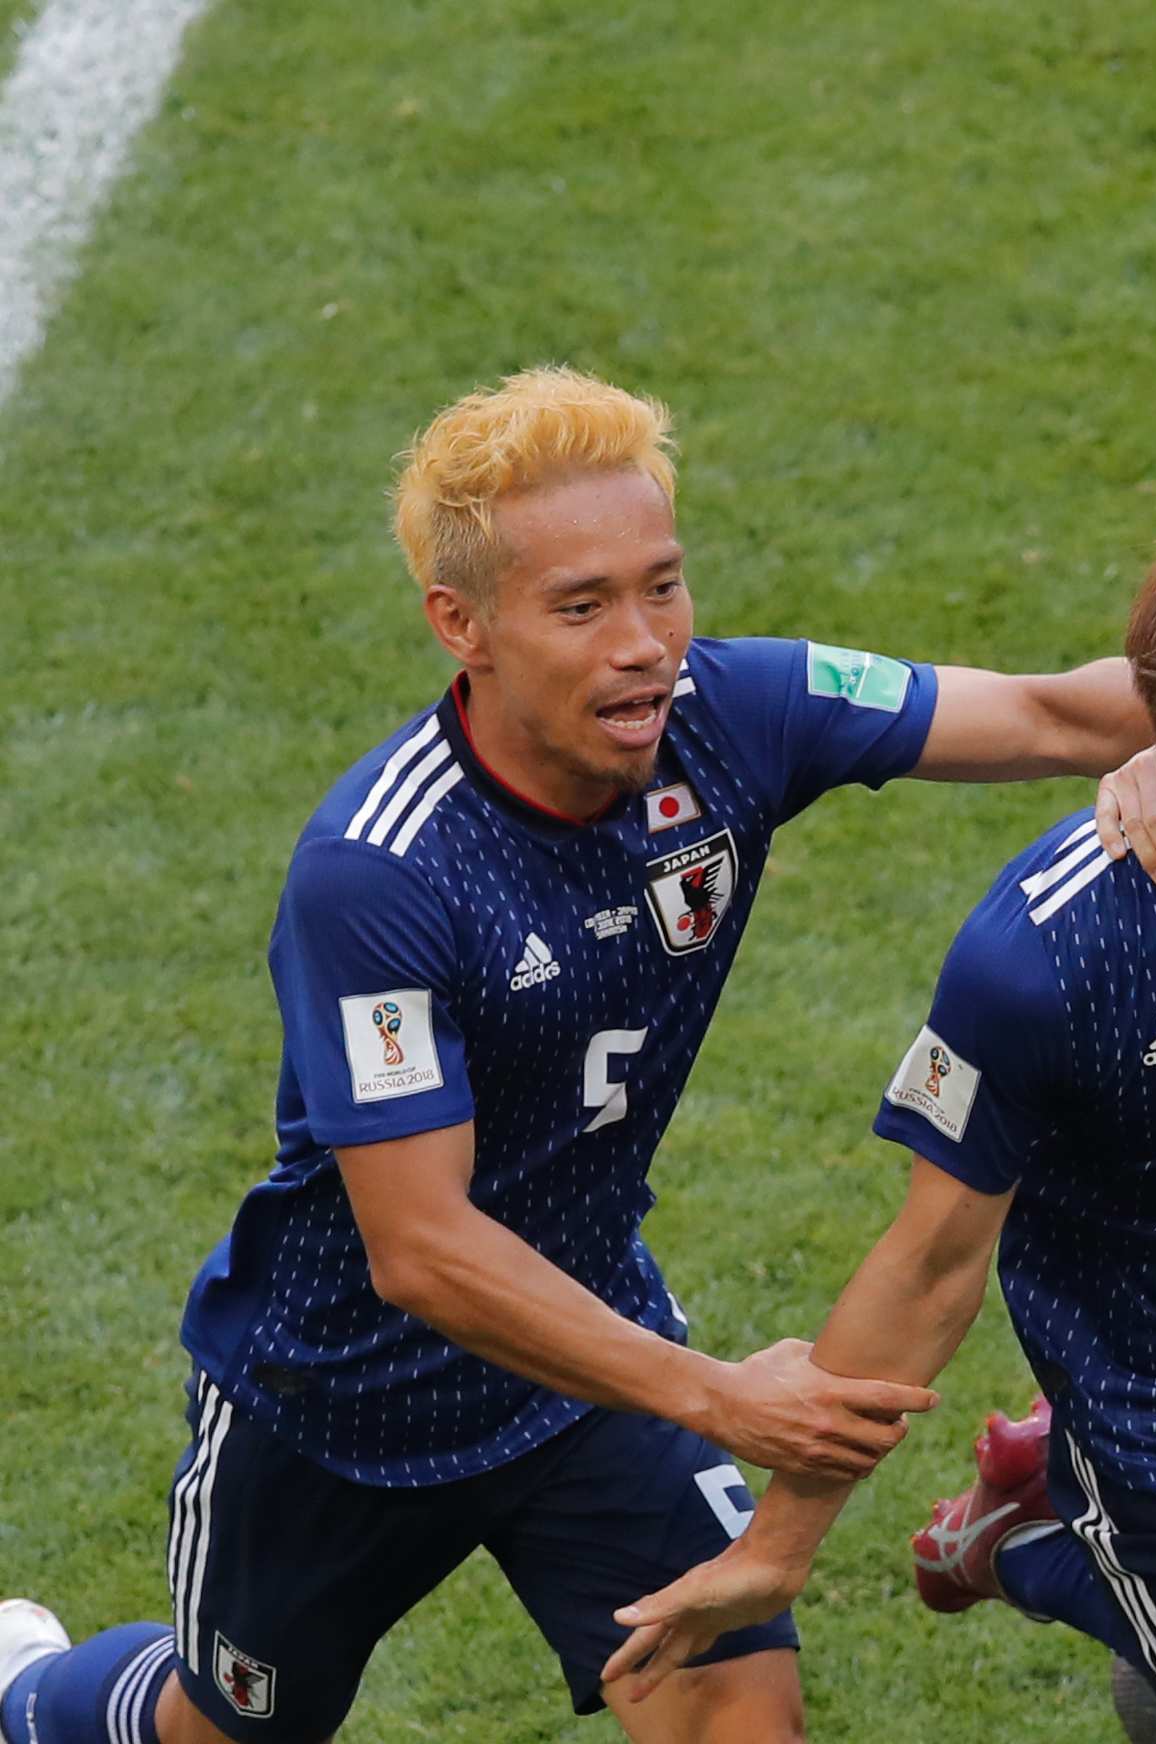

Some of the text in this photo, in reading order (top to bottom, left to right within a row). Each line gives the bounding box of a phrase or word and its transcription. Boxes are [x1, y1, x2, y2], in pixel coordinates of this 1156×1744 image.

[663, 844, 711, 873] JAPAN
[358, 1068, 434, 1094] RUSSIA 2018
[582, 1026, 648, 1133] 5
